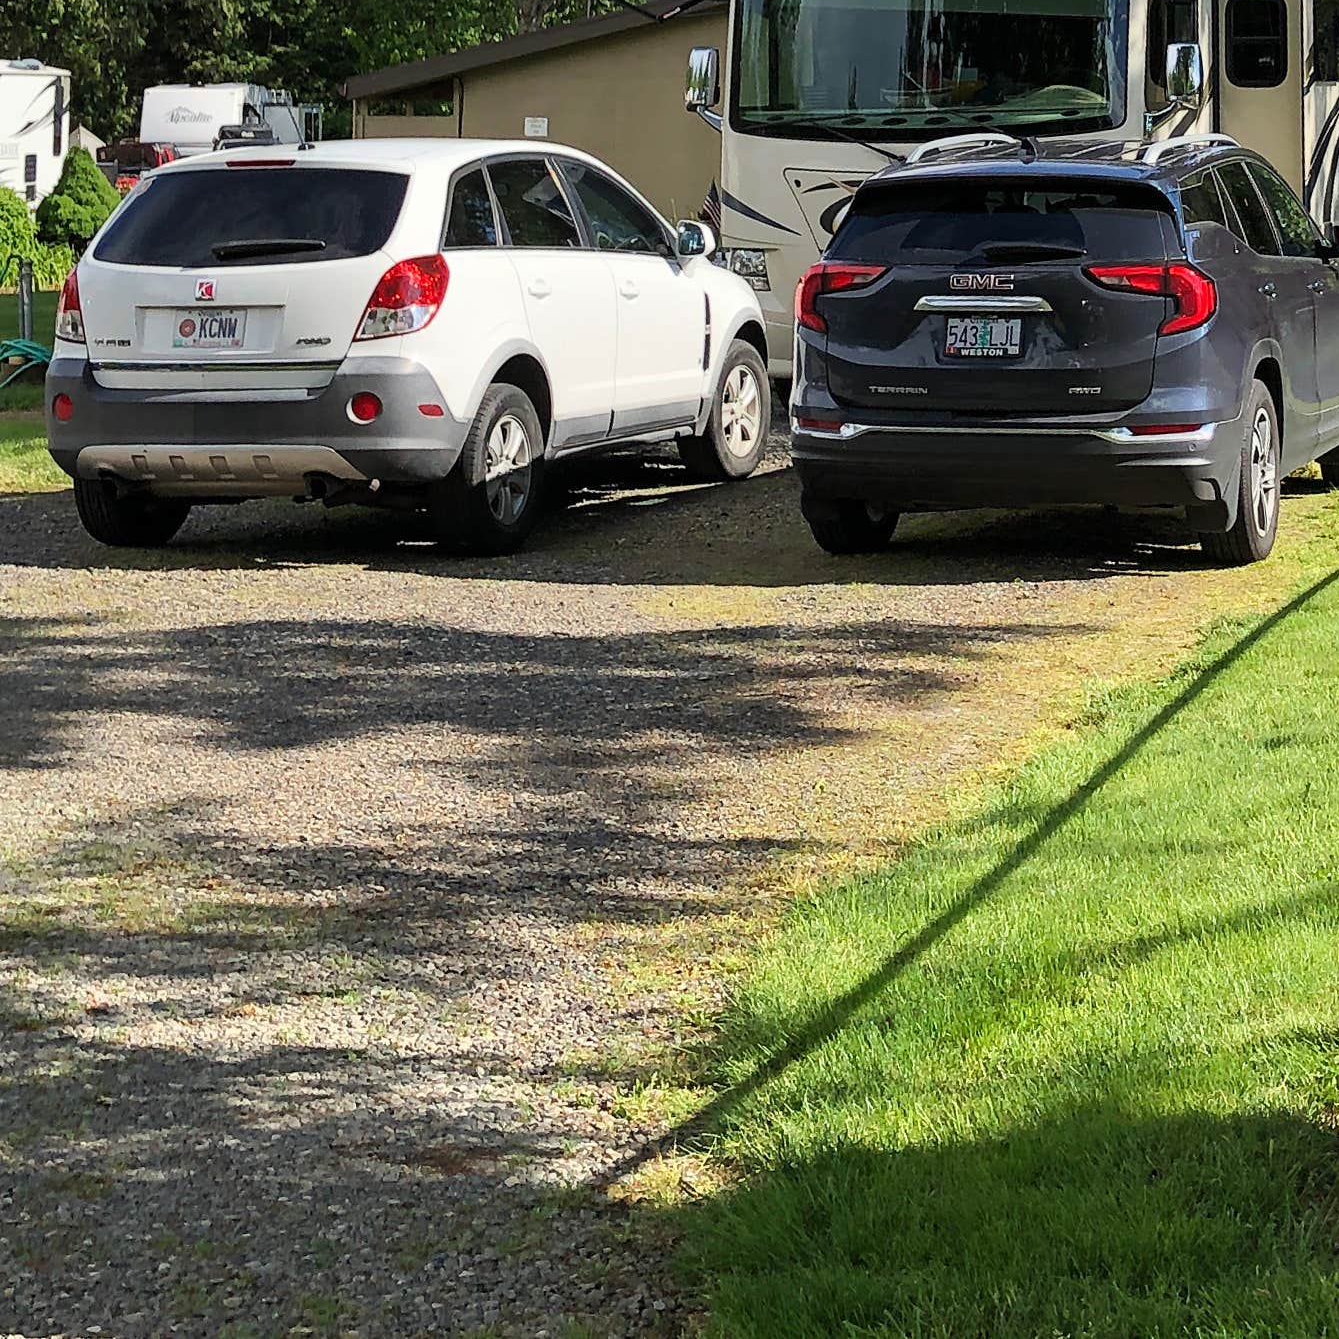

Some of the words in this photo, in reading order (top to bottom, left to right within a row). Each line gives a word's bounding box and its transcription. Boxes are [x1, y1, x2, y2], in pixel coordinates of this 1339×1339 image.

[950, 274, 1014, 290] GMC
[948, 325, 979, 347] 543
[989, 325, 1018, 347] LJL
[961, 348, 1003, 356] WESTON
[868, 386, 928, 394] TERRAIN
